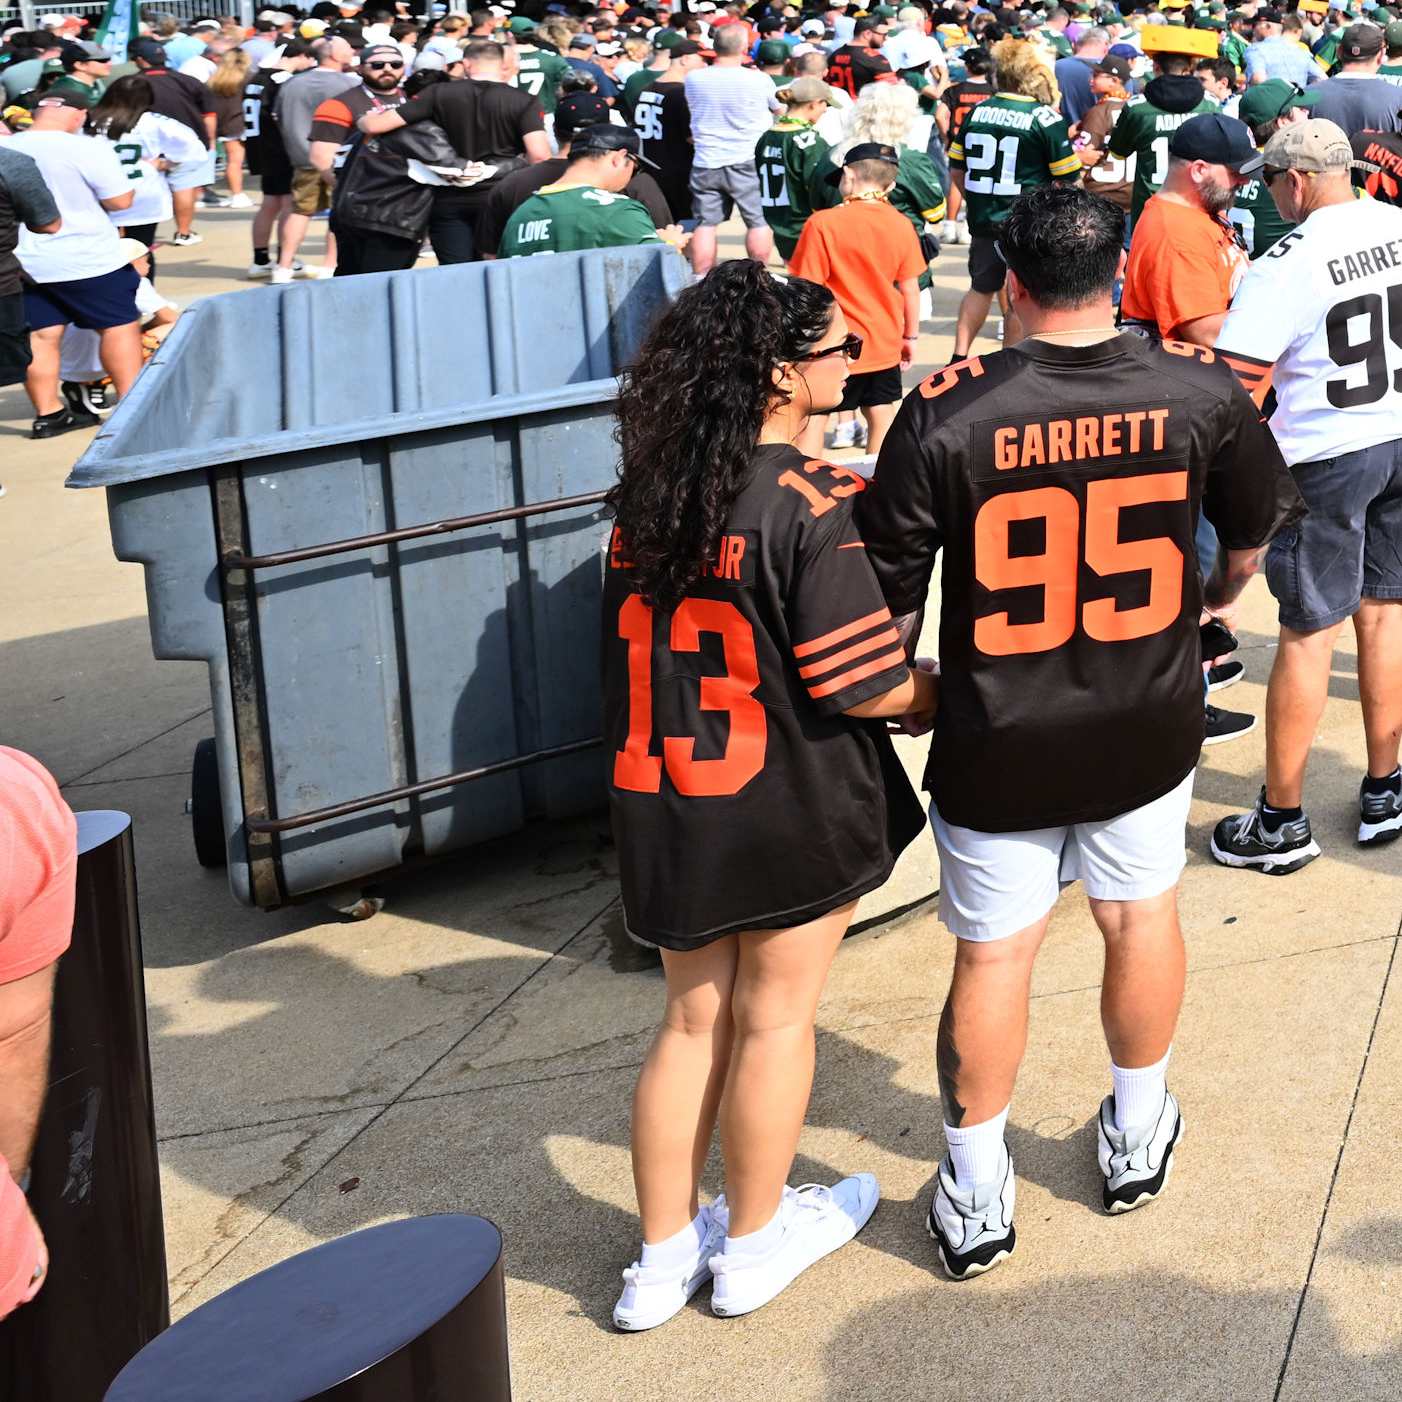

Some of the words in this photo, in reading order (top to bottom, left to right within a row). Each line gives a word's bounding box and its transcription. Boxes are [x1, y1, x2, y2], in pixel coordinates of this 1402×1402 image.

[634, 103, 663, 141] 95
[971, 106, 1034, 131] WOODSON
[759, 163, 791, 207] 17
[964, 131, 1022, 196] 21
[517, 219, 552, 244] LOVE
[918, 356, 985, 399] 5
[993, 408, 1169, 470] GARRETT
[777, 459, 867, 518] 13
[973, 471, 1188, 657] 95
[613, 592, 768, 797] 13
